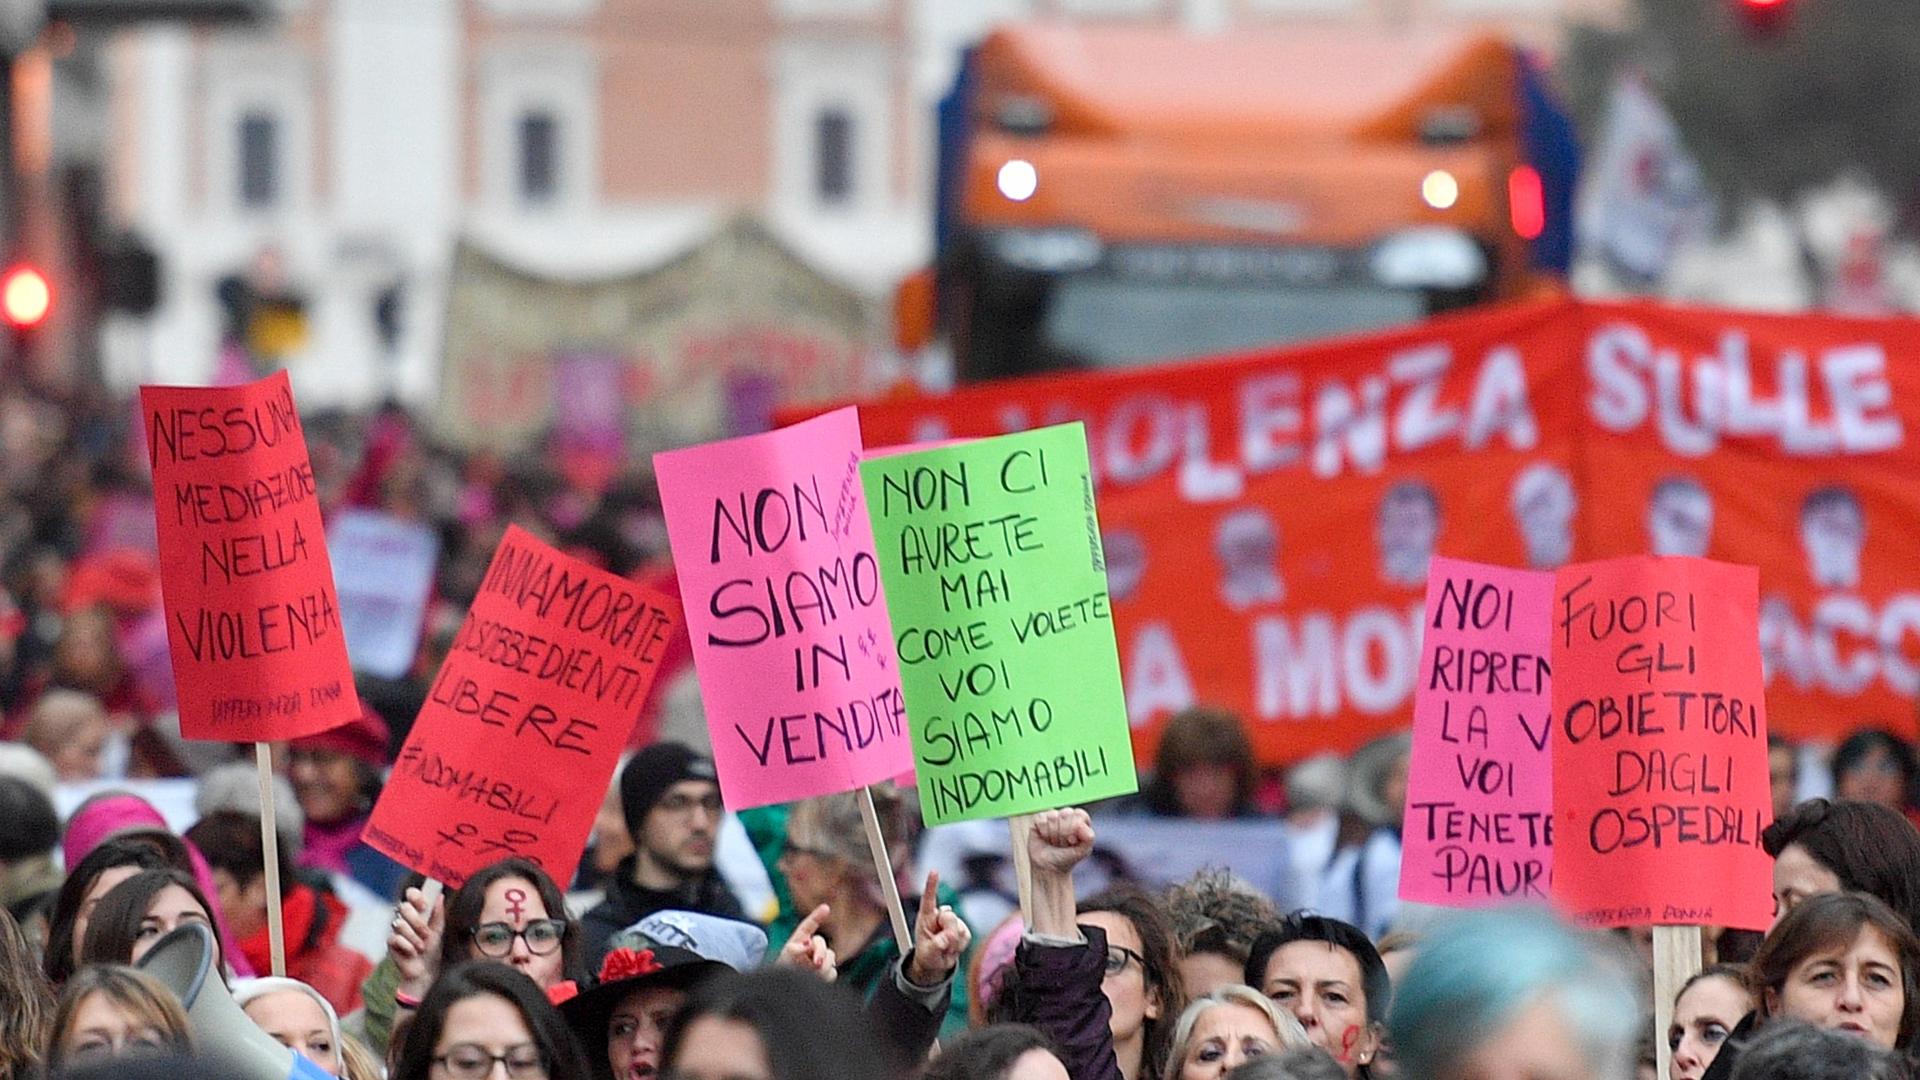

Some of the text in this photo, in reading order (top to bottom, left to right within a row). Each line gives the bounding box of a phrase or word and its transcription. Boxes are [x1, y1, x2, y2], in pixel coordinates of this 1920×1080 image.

[1586, 319, 1905, 459] SULLE
[152, 385, 298, 468] NESSUNA
[882, 461, 970, 518] NON
[1000, 448, 1048, 494] CI
[202, 518, 308, 586] NELLA
[711, 474, 829, 564] NON
[900, 514, 1044, 575] AVRETE
[177, 587, 337, 662] VIOLENZA
[708, 552, 878, 647] SIAMO
[940, 569, 1010, 613] MAI
[1433, 578, 1514, 632] NOI
[1560, 576, 1696, 649] FUORI
[897, 592, 1110, 665] COME VOLETE
[795, 635, 851, 692] IN
[939, 659, 1010, 703] VOI
[1615, 643, 1696, 684] GLI
[432, 663, 598, 755] LIBERE
[735, 686, 905, 767] VENDITA
[923, 698, 1053, 766] SIAMO
[1441, 700, 1489, 749] LA
[1563, 691, 1758, 744] OBIETTORI
[930, 746, 1109, 820] INDOMABILI
[1457, 754, 1514, 798] VOI
[1608, 750, 1733, 797] DAGLI
[1589, 804, 1763, 855] OSPEDALI
